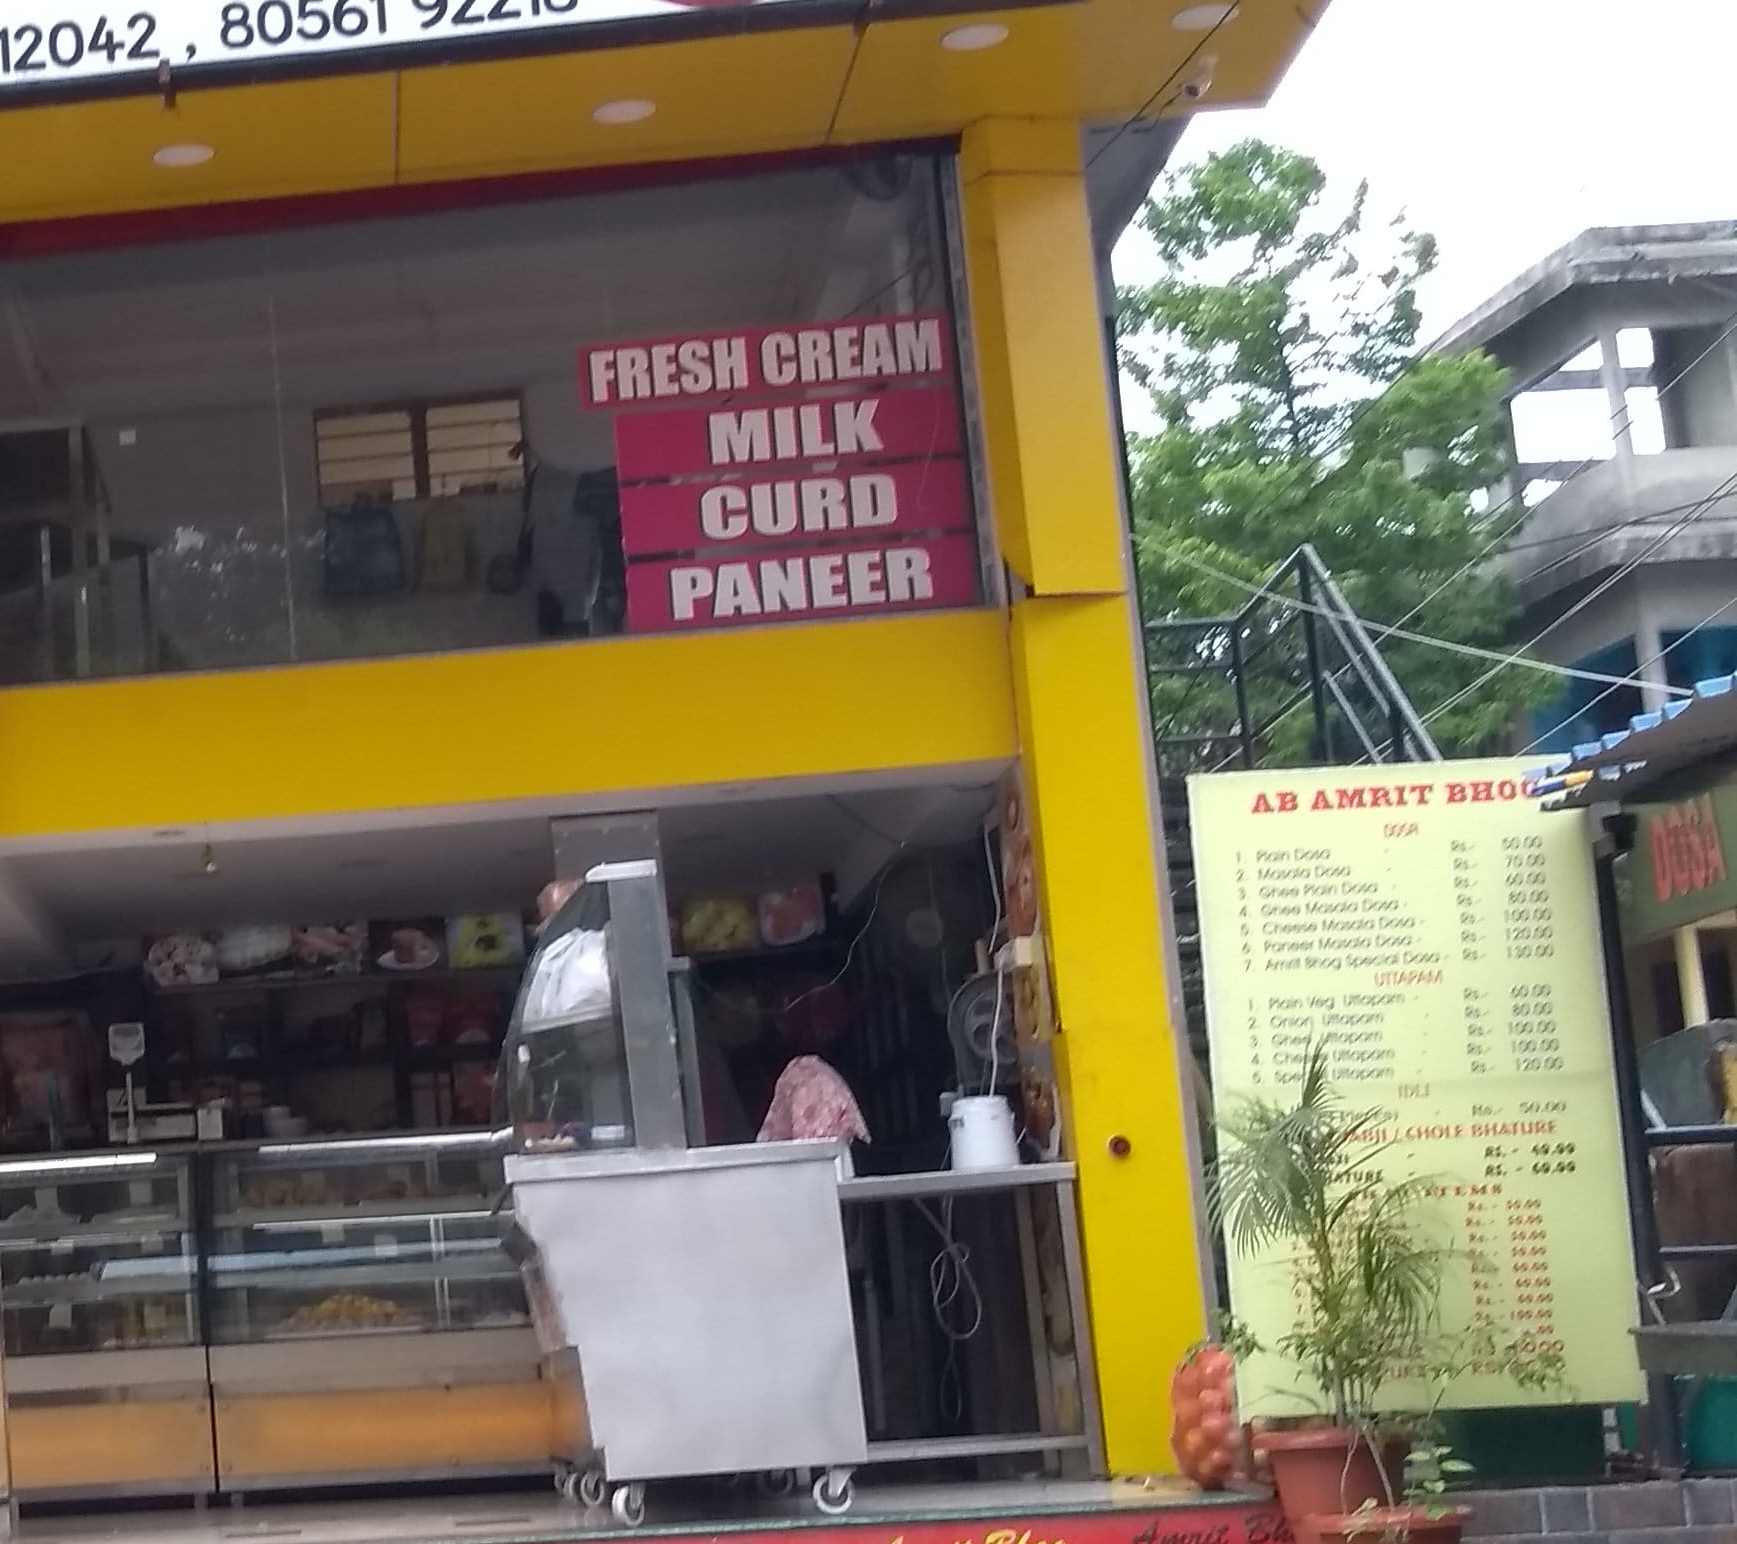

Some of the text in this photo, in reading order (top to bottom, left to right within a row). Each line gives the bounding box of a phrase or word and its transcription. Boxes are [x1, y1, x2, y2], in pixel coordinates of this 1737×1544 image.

[589, 319, 942, 403] FRESH CREAM
[708, 399, 884, 465] MILK
[700, 474, 898, 541] CURD
[670, 549, 934, 621] PANEER
[1251, 791, 1299, 815] AB
[1310, 783, 1434, 811] AMRIT
[1294, 848, 1331, 861] Dosa
[1257, 865, 1352, 881] Masala Dosa
[1341, 881, 1378, 895] Dosa
[1305, 901, 1359, 915] Masala
[1361, 898, 1399, 913] Dosa
[1321, 919, 1376, 932] Masala
[1378, 916, 1415, 929] Dosa
[1318, 937, 1372, 950] Masala
[1375, 935, 1412, 948] Dosa
[1403, 950, 1441, 964] Dosa
